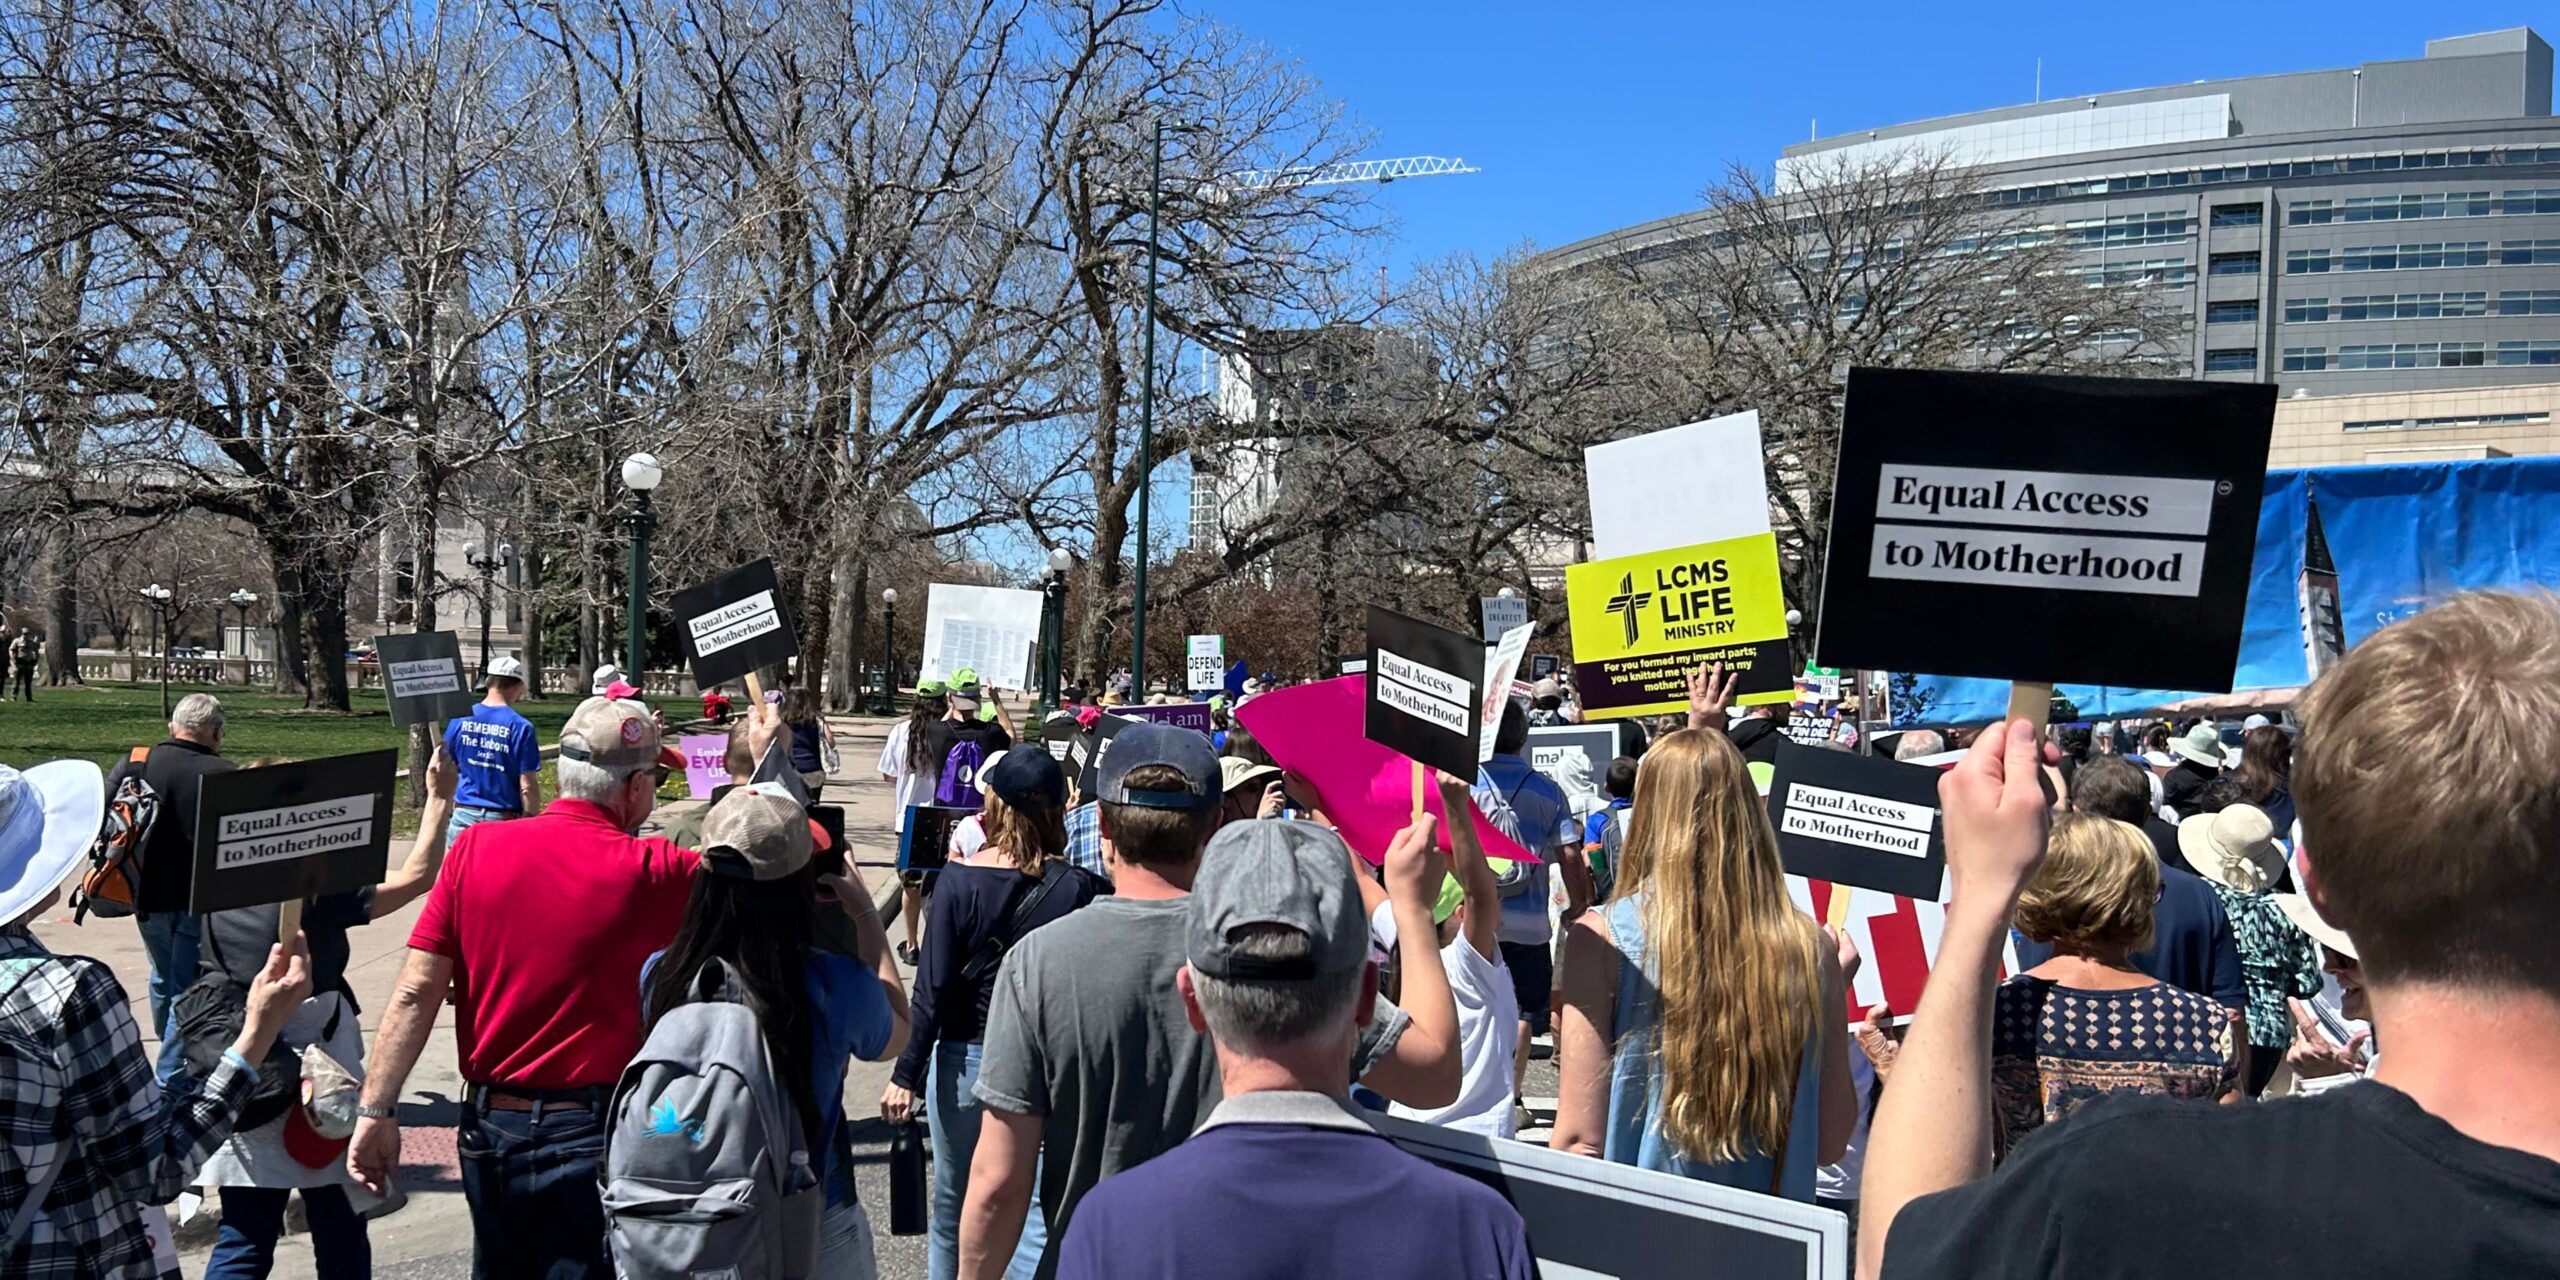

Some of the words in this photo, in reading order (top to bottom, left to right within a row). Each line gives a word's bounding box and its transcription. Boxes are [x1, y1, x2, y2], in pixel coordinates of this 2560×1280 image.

[1891, 476, 2005, 514] Equal
[2011, 482, 2149, 517] Access
[1885, 540, 1923, 567] to
[1931, 540, 2183, 582] Motherhood
[1656, 559, 1728, 591] LCMS
[693, 613, 723, 633] Equal
[724, 601, 758, 621] Access
[1660, 586, 1733, 623] LIFE
[700, 642, 711, 652] to
[712, 615, 775, 648] Motherhood
[1664, 619, 1735, 640] MINISTRY
[392, 664, 416, 676] Equal
[417, 662, 443, 674] Access
[1189, 656, 1222, 670] DEFEND
[1604, 663, 1619, 672] For
[1621, 661, 1638, 672] you
[1640, 656, 1674, 668] formed
[1676, 655, 1690, 664] my
[1693, 649, 1725, 661] inward
[1728, 647, 1757, 660] parts;
[1197, 671, 1214, 684] LIFE
[1382, 655, 1410, 679] Equal
[1413, 668, 1452, 694] Access
[1611, 675, 1628, 685] you
[1629, 668, 1663, 681] knitted
[1665, 669, 1679, 678] me
[1725, 661, 1734, 670] in
[1736, 660, 1752, 671] my
[1644, 679, 1686, 691] mother's
[396, 685, 406, 694] to
[406, 679, 455, 692] Motherhood
[1381, 684, 1392, 698] to
[1394, 689, 1463, 727] Motherhood
[1176, 713, 1204, 727] am
[1788, 716, 1810, 728] EZA
[461, 734, 478, 747] The
[696, 747, 727, 757] Embr
[692, 755, 724, 768] EVE
[708, 767, 727, 778] LIF
[1793, 788, 1844, 809] Equal
[1846, 799, 1906, 821] Access
[226, 813, 282, 835] Equal
[285, 805, 348, 826] Access
[1789, 815, 1806, 829] to
[1809, 818, 1919, 850] Motherhood
[224, 849, 243, 862] to
[247, 827, 363, 860] Motherhood
